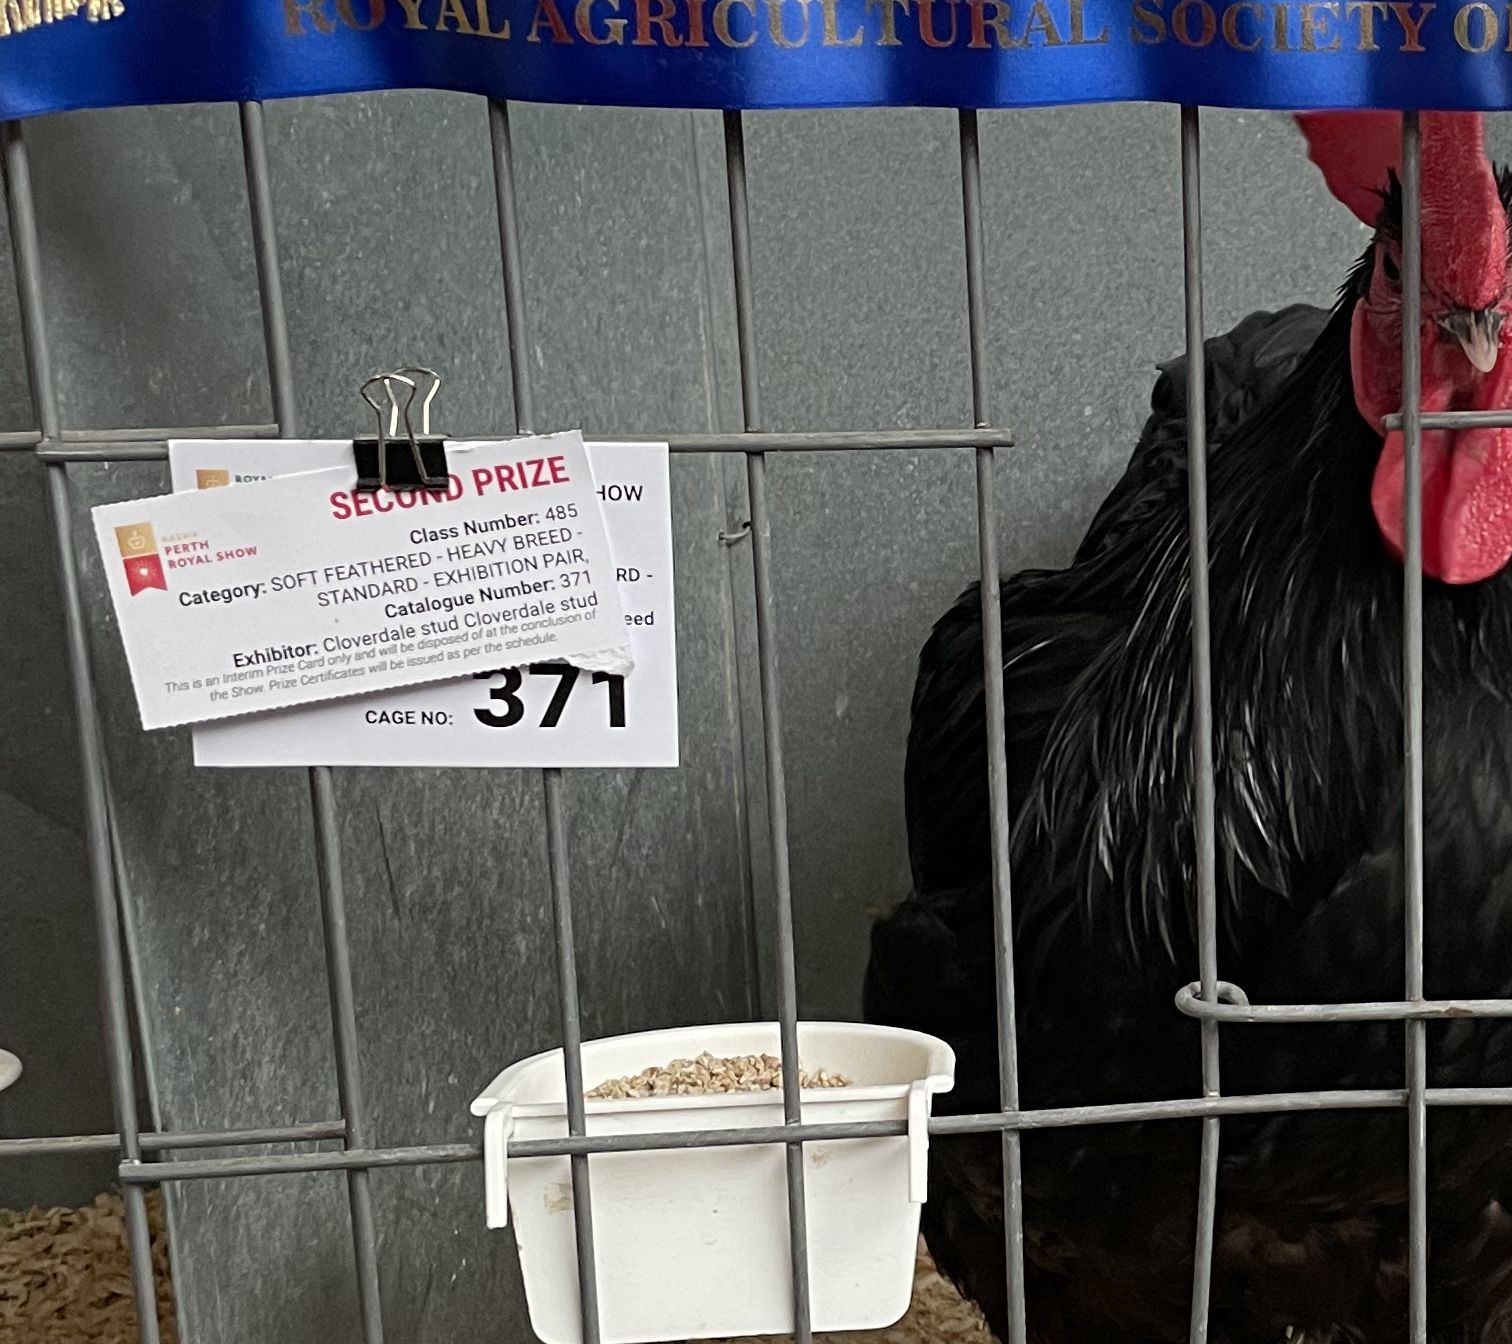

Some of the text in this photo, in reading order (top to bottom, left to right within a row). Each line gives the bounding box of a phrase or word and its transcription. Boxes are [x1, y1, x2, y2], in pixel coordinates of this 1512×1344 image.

[329, 455, 570, 520] SECOND PRIZE
[164, 540, 210, 556] PERTH
[410, 503, 578, 545] Class Number: 485
[168, 545, 258, 570] ROYAL SHOW
[178, 582, 267, 607] Category:
[270, 570, 319, 592] SOFT
[325, 552, 432, 584] FEATHERED
[446, 537, 507, 563] HEAVY
[514, 527, 573, 550] BREED
[317, 576, 418, 607] STANDARD
[433, 558, 538, 587] EXHIBITION
[544, 548, 590, 570] PAIR,
[384, 570, 592, 618] Catalogue Number: 371
[165, 608, 597, 693] This is an Interim Prize Card only and will be disposed of at the conclusion of
[233, 591, 599, 668] Exhibitor: Cloverdale stud Cloverdale stud
[209, 689, 229, 701] the
[269, 677, 297, 691] Prize
[300, 665, 366, 686] Certificates
[368, 661, 388, 674] will
[390, 658, 405, 670] be
[407, 652, 446, 668] issued
[447, 649, 461, 660] as
[463, 645, 481, 660] per
[483, 642, 503, 655] the
[365, 662, 626, 728] CAGE NO: 371
